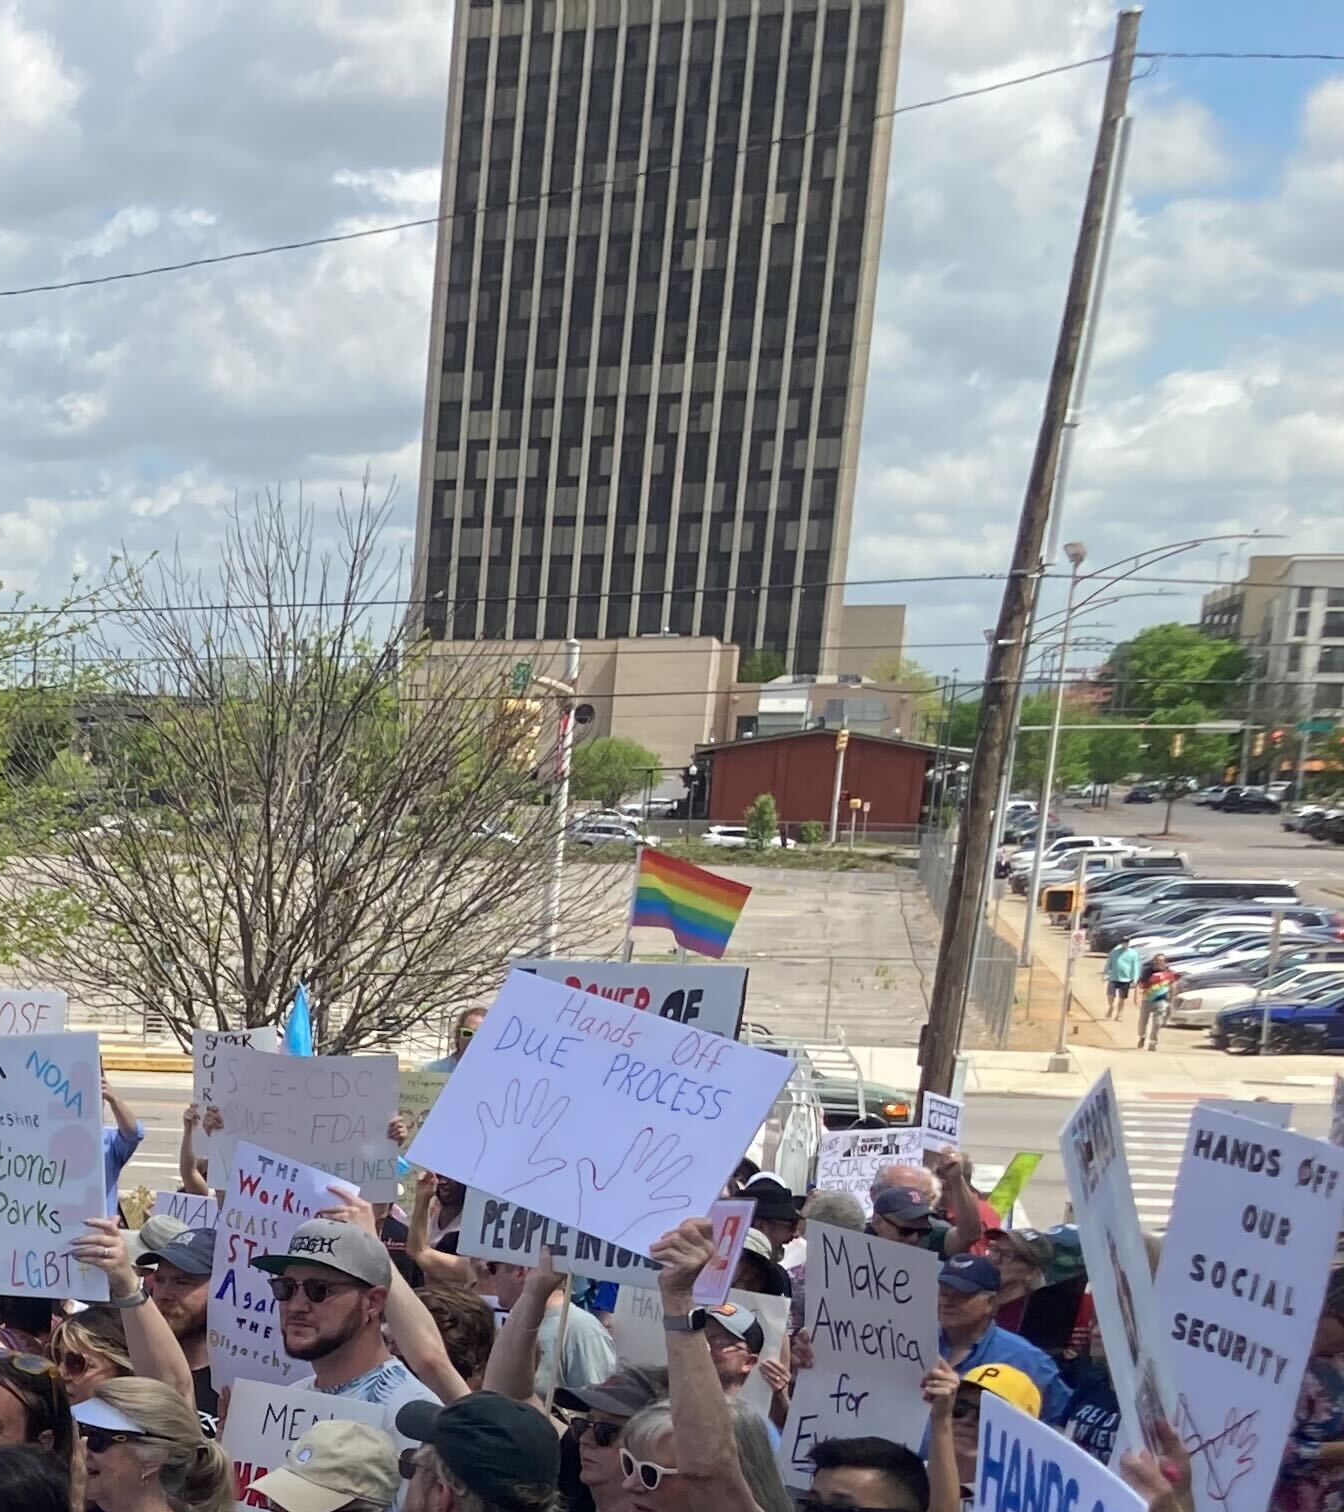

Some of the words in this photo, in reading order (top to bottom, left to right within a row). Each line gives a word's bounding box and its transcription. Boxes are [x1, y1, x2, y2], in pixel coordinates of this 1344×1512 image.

[556, 993, 641, 1049] Hands
[25, 1050, 84, 1118] NOAA
[494, 1015, 584, 1068] DUE
[602, 1053, 732, 1121] PROCESS
[312, 1113, 367, 1145] FDA
[1193, 1128, 1281, 1178] HANDS
[257, 1155, 298, 1182] THE
[821, 1159, 868, 1178] SOCIAL
[1242, 1203, 1292, 1246] OUR
[821, 1232, 913, 1305] Make
[1188, 1252, 1295, 1317] SOCIAL
[236, 1317, 274, 1340] THE
[812, 1299, 926, 1371] America
[1170, 1311, 1290, 1386] SECURITY
[829, 1372, 870, 1417] for
